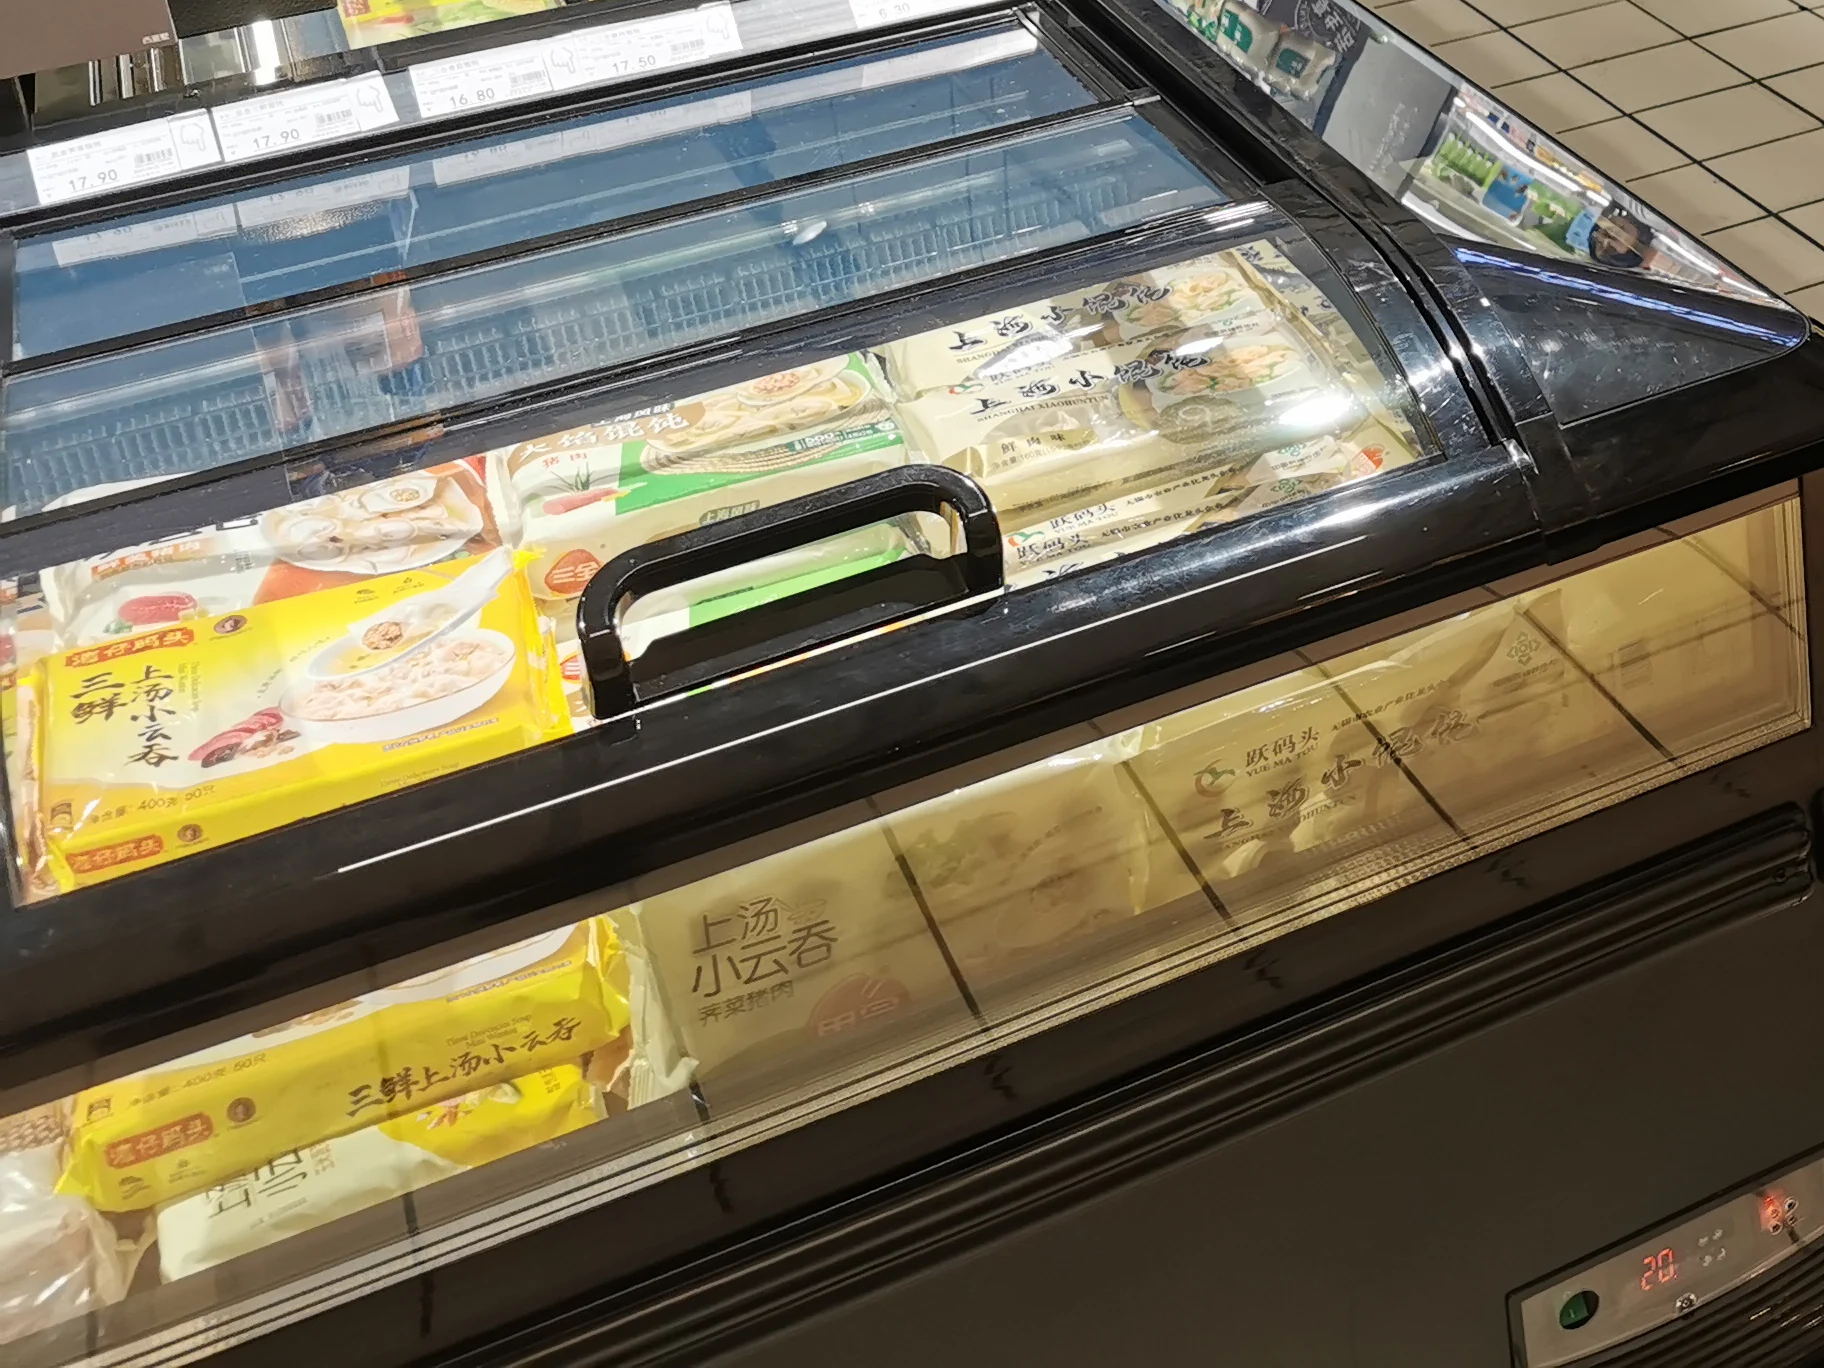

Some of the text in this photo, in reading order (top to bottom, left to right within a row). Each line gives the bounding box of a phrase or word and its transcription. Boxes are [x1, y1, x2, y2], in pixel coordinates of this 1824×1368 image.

[611, 54, 657, 75] 17.50
[448, 87, 496, 107] 16.80
[252, 129, 301, 150] 17.90
[68, 168, 119, 192] 17.90
[520, 413, 689, 460] 大馅馄饨
[1001, 432, 1066, 456] 鲜肉味
[542, 452, 588, 469] 猪肉
[1050, 503, 1116, 530] 跃码头
[1016, 533, 1088, 560] 跃码头
[552, 560, 600, 585] 三全
[71, 630, 190, 666] 湾仔码头
[70, 671, 129, 725] 三鲜
[123, 665, 180, 768] 上汤小云吞
[1246, 725, 1320, 768] 跃码头
[1246, 742, 1320, 779] YUE MA TOU
[692, 895, 781, 955] 上汤
[692, 919, 839, 999] 小云吞
[699, 979, 795, 1027] 荠菜猪肉
[347, 1017, 582, 1117] 三鲜上汤小云吞
[109, 1117, 208, 1165] 湾仔码头
